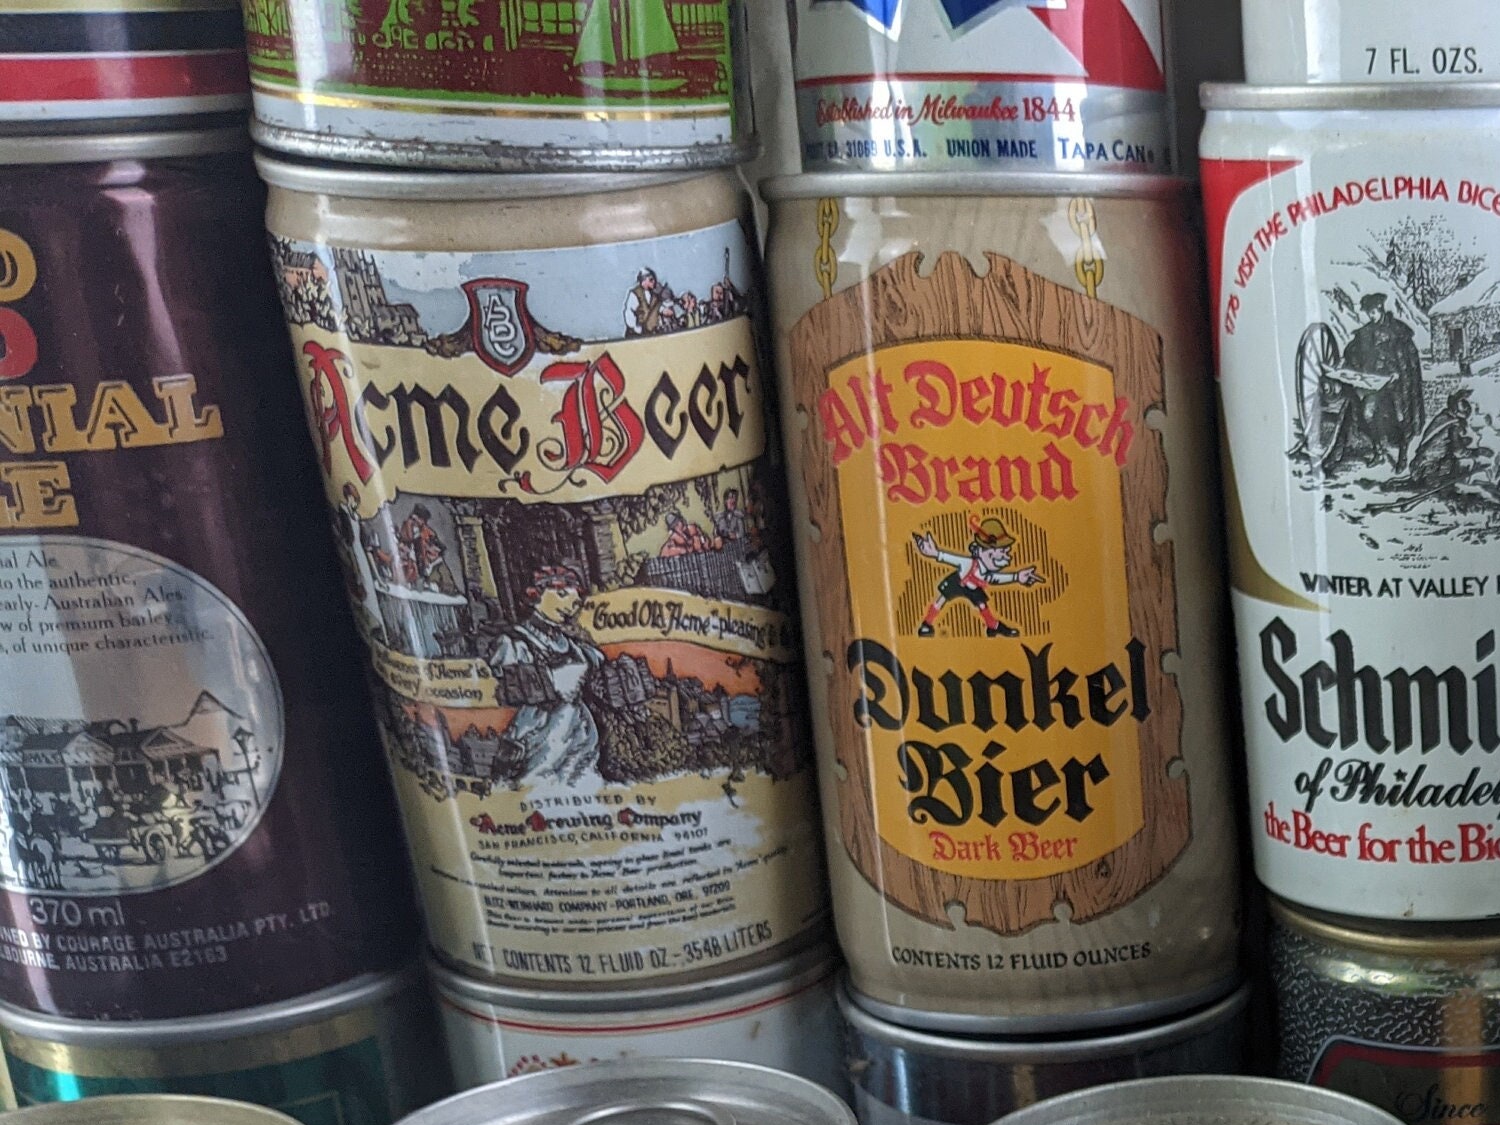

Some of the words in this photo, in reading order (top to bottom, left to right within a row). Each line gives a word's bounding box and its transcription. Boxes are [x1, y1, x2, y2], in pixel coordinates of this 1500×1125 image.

[1365, 47, 1378, 74] 7
[1390, 47, 1421, 74] FL.
[1431, 46, 1484, 74] OZS.
[816, 98, 892, 126] Established
[894, 100, 913, 121] in
[909, 95, 1018, 125] Milwaukee
[1023, 97, 1076, 123] 1844
[884, 139, 927, 160] U.S.A.
[946, 139, 990, 159] UNION
[998, 139, 1037, 159] MADE
[1234, 249, 1259, 289] VISIT
[1254, 215, 1287, 254] THE
[1286, 175, 1450, 228] PHILADELPHIA
[302, 340, 530, 488] Acme
[522, 352, 753, 486] Beer
[818, 367, 900, 465] Alt
[903, 360, 1136, 467] Deutsch
[876, 440, 1079, 505] Brand
[1299, 571, 1373, 598] WINTER
[1378, 577, 1402, 598] AT
[1410, 576, 1489, 598] VALLEY
[846, 638, 1153, 733] Dunkel
[897, 740, 1110, 828] Bier
[1294, 756, 1333, 813] of
[520, 795, 624, 813] DISTRIBUTED
[636, 795, 657, 807] BY
[470, 813, 526, 835] Acme
[526, 810, 613, 832] Brewing
[617, 808, 703, 831] Company
[1264, 801, 1291, 843] the
[1292, 810, 1351, 858] Beer
[1357, 822, 1401, 862] for
[1406, 825, 1456, 864] the
[478, 839, 501, 850] SAN
[580, 831, 665, 843] CALIFORNIA
[928, 830, 1000, 861] Dark
[1008, 831, 1078, 862] Beer
[29, 897, 82, 927] 370
[88, 898, 125, 927] ml
[31, 930, 51, 950] BY
[57, 933, 137, 953] COURAGE
[144, 922, 250, 950] AUSTRALIA
[503, 951, 572, 974] CONTENTS
[578, 954, 595, 973] 12
[600, 947, 644, 973] FLUID
[722, 920, 773, 954] LITERS
[65, 951, 164, 972] AUSTRALIA
[892, 947, 981, 970] CONTENTS
[986, 953, 1004, 968] 12
[1010, 951, 1067, 970] FLUID
[1073, 942, 1152, 968] OUNCES
